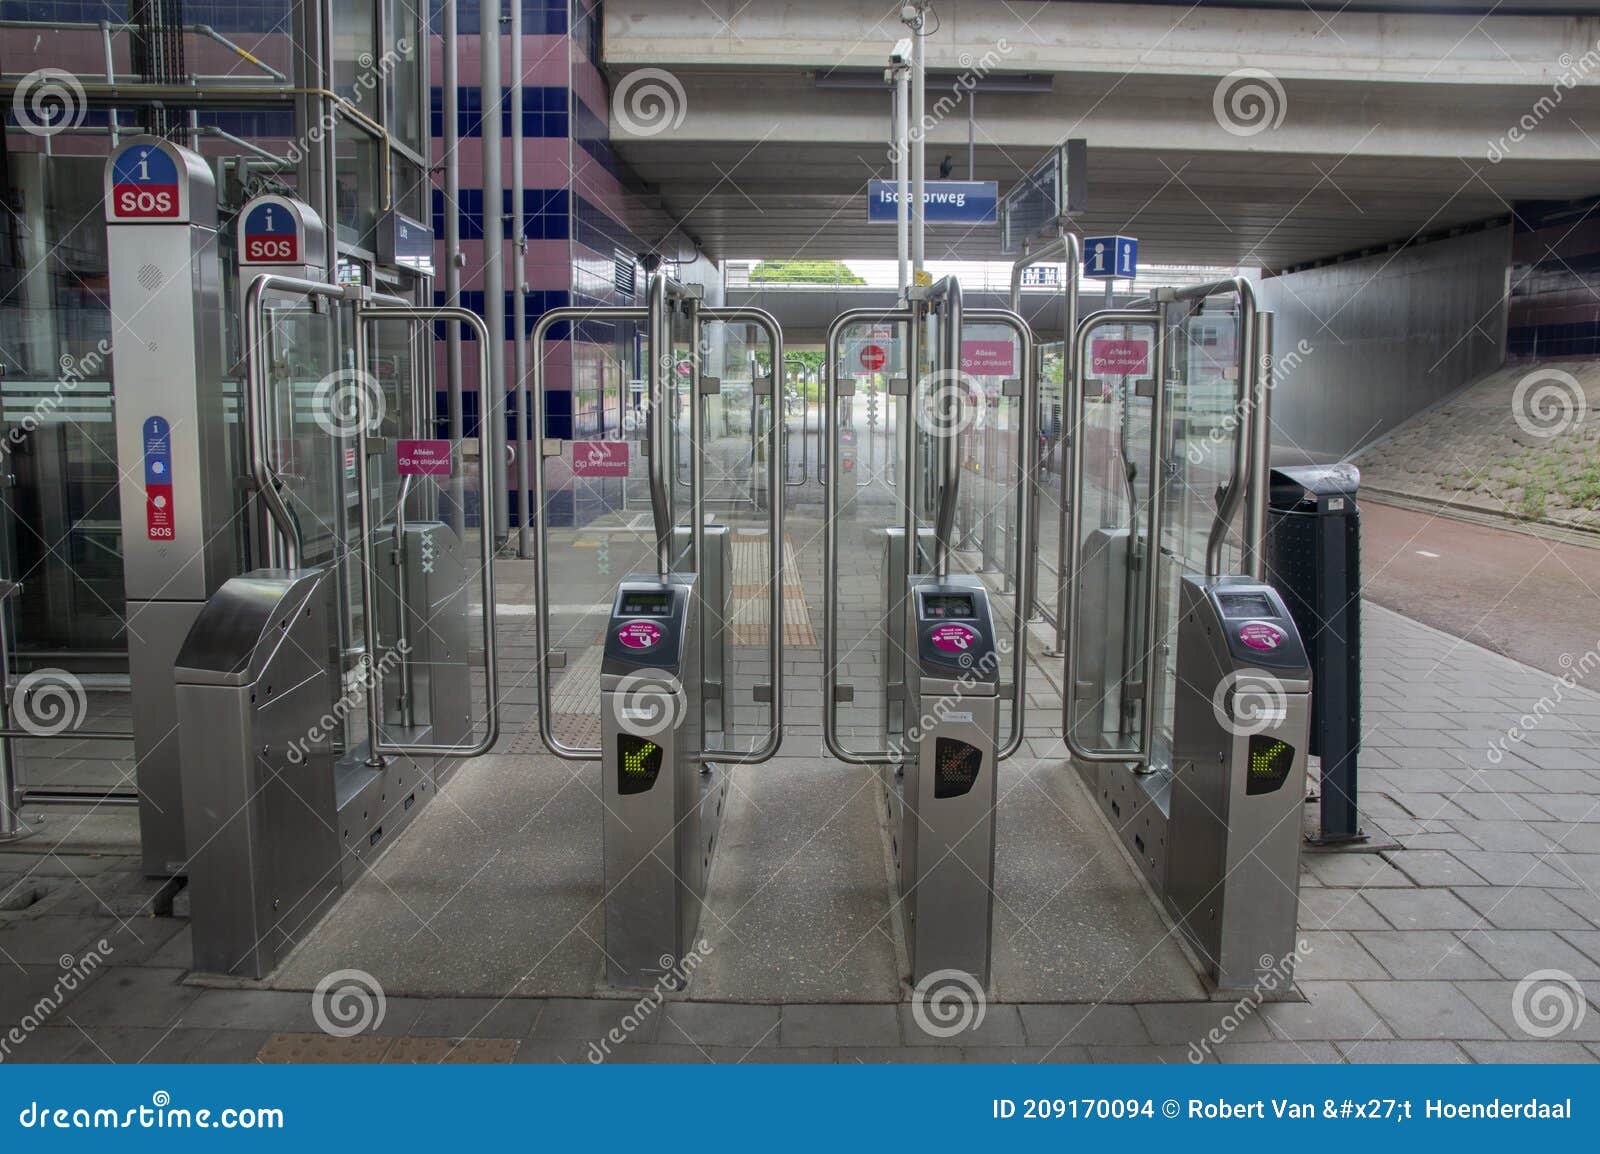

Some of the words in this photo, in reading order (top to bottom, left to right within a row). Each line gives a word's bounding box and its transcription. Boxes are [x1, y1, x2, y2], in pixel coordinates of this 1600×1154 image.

[121, 192, 172, 212] SOS
[250, 241, 291, 257] SOS
[150, 527, 172, 537] SOS
